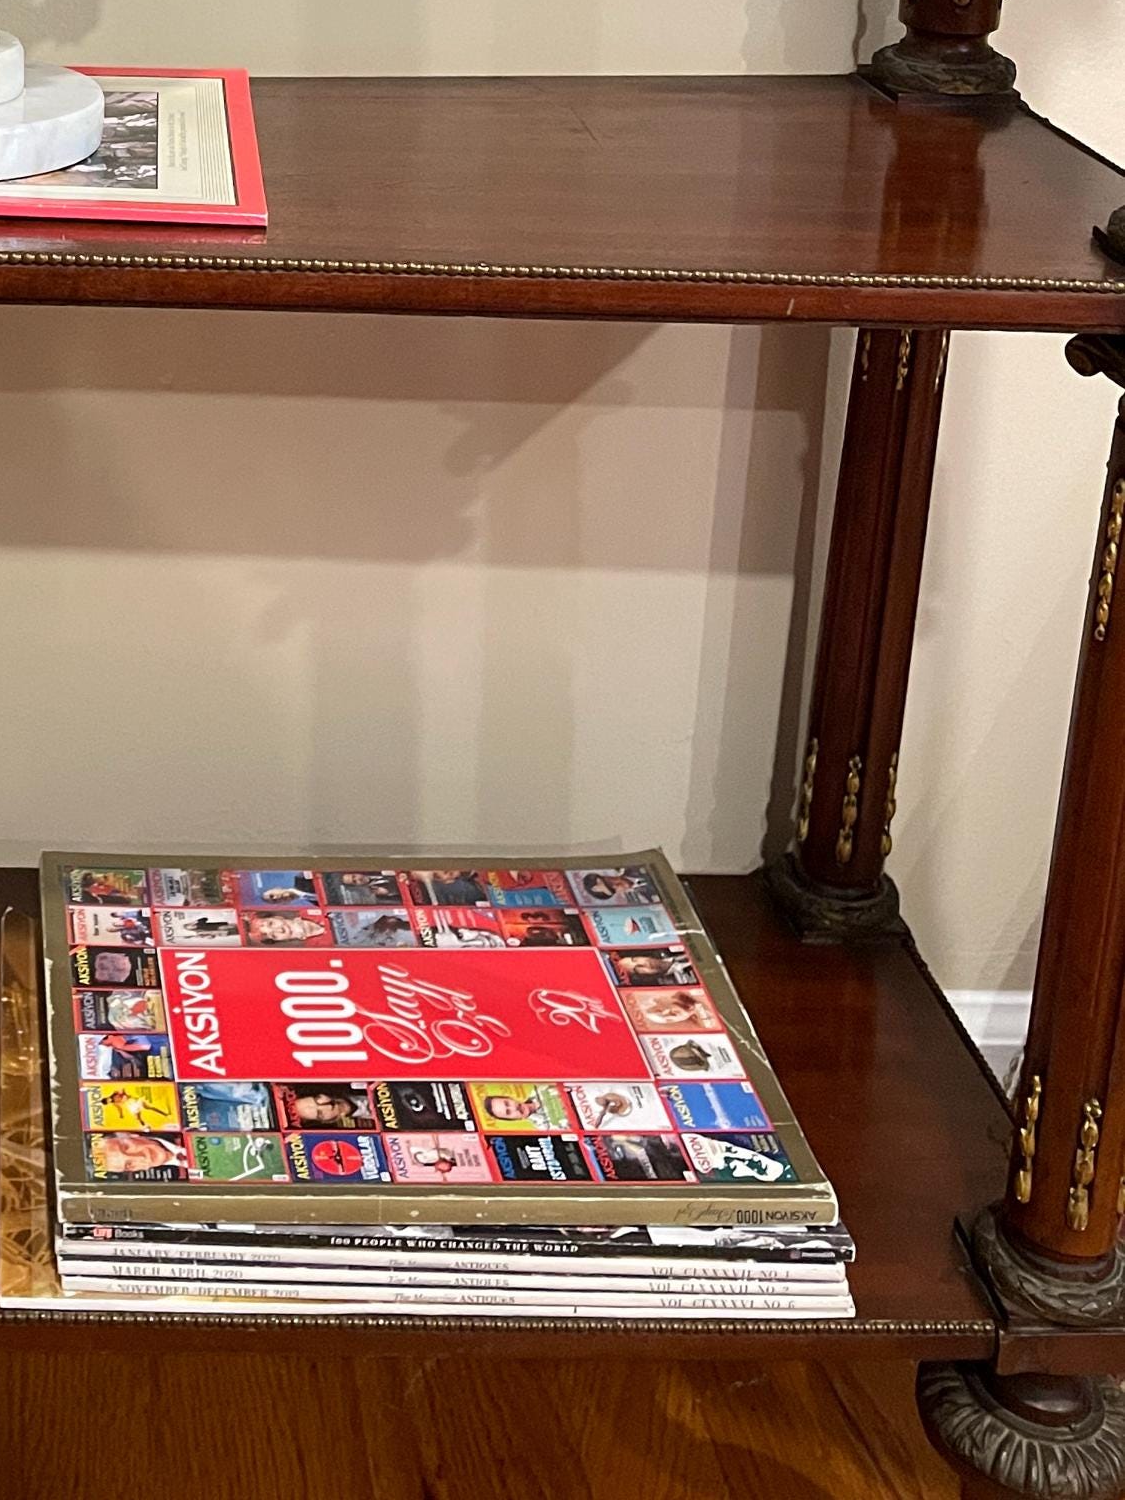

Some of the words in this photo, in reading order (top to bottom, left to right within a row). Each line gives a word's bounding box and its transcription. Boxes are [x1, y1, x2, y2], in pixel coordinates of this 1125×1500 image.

[173, 952, 226, 1076] AKSİYON
[275, 959, 369, 1069] 1000.
[528, 988, 601, 1034] 20
[525, 1144, 547, 1171] RANT
[115, 1229, 144, 1239] Books
[330, 1236, 350, 1246] 100
[354, 1237, 402, 1247] PEOPLE
[406, 1239, 436, 1248] WHO
[440, 1240, 501, 1251] CHANGED
[505, 1242, 530, 1252] THE
[534, 1243, 579, 1253] WORLD
[454, 1261, 510, 1270] ANTIQUES
[454, 1278, 510, 1286] ANTIQUES
[461, 1295, 515, 1304] ANTIQUES
